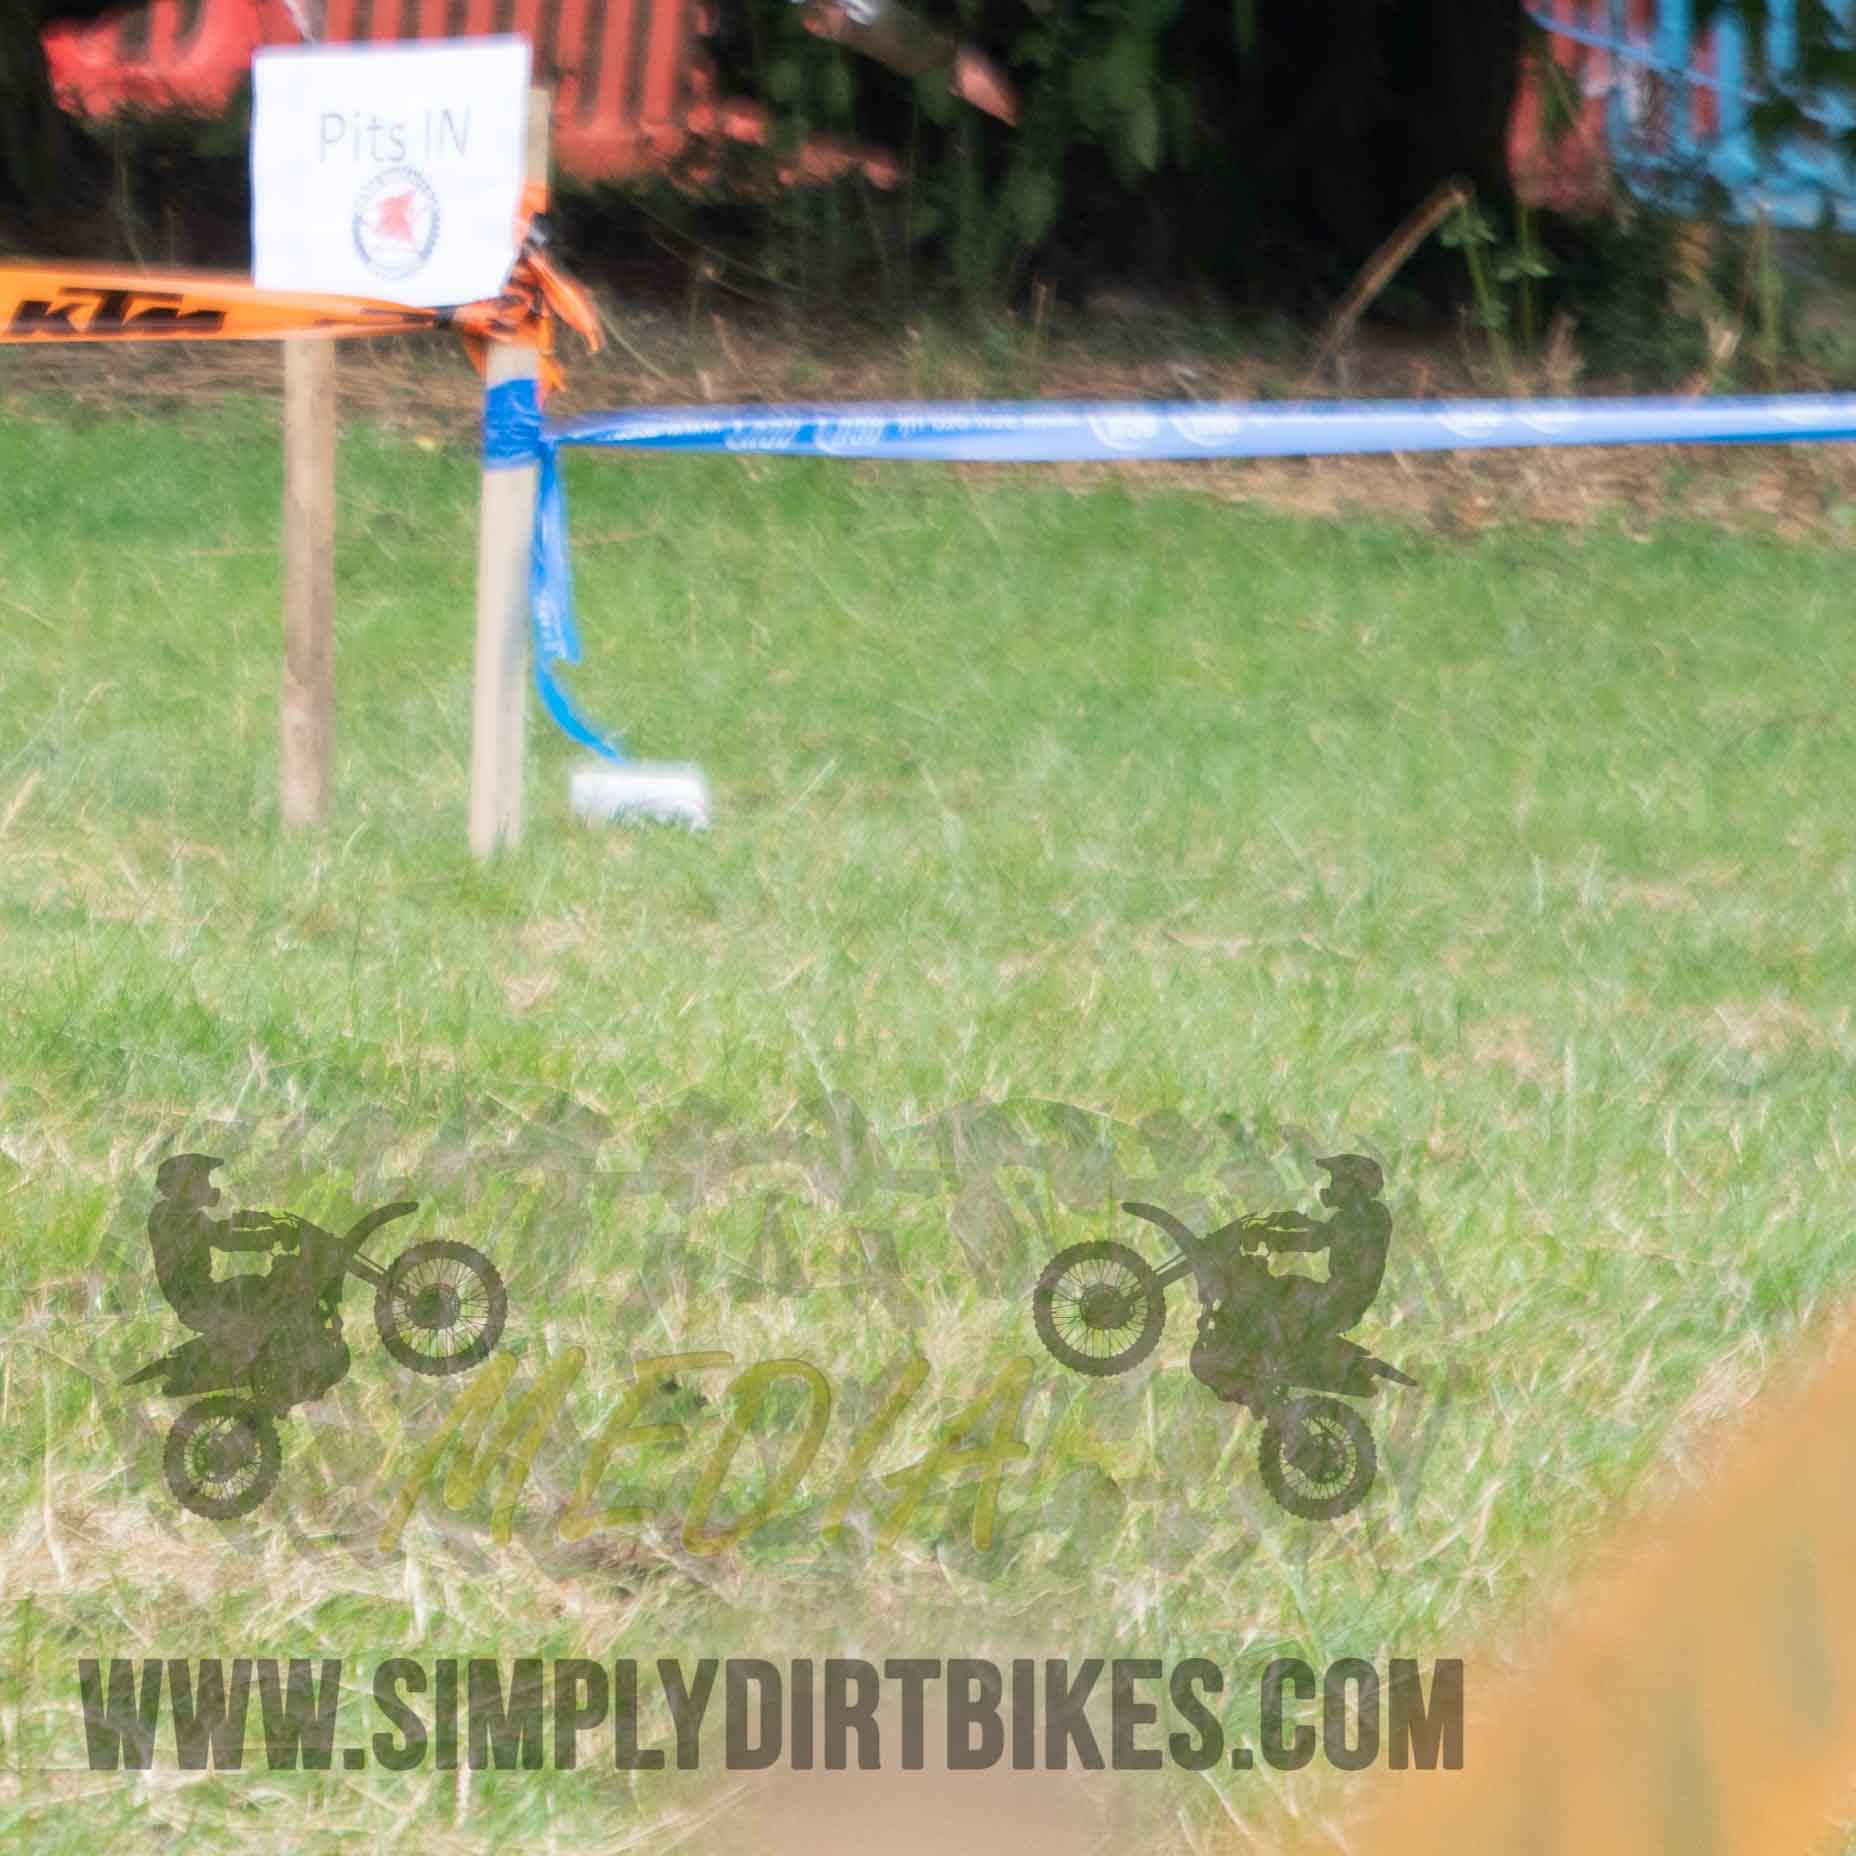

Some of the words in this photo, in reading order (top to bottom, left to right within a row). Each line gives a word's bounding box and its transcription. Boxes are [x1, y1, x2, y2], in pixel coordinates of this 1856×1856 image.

[319, 110, 407, 164] Pits
[423, 104, 472, 161] IN
[3, 287, 227, 338] KTM
